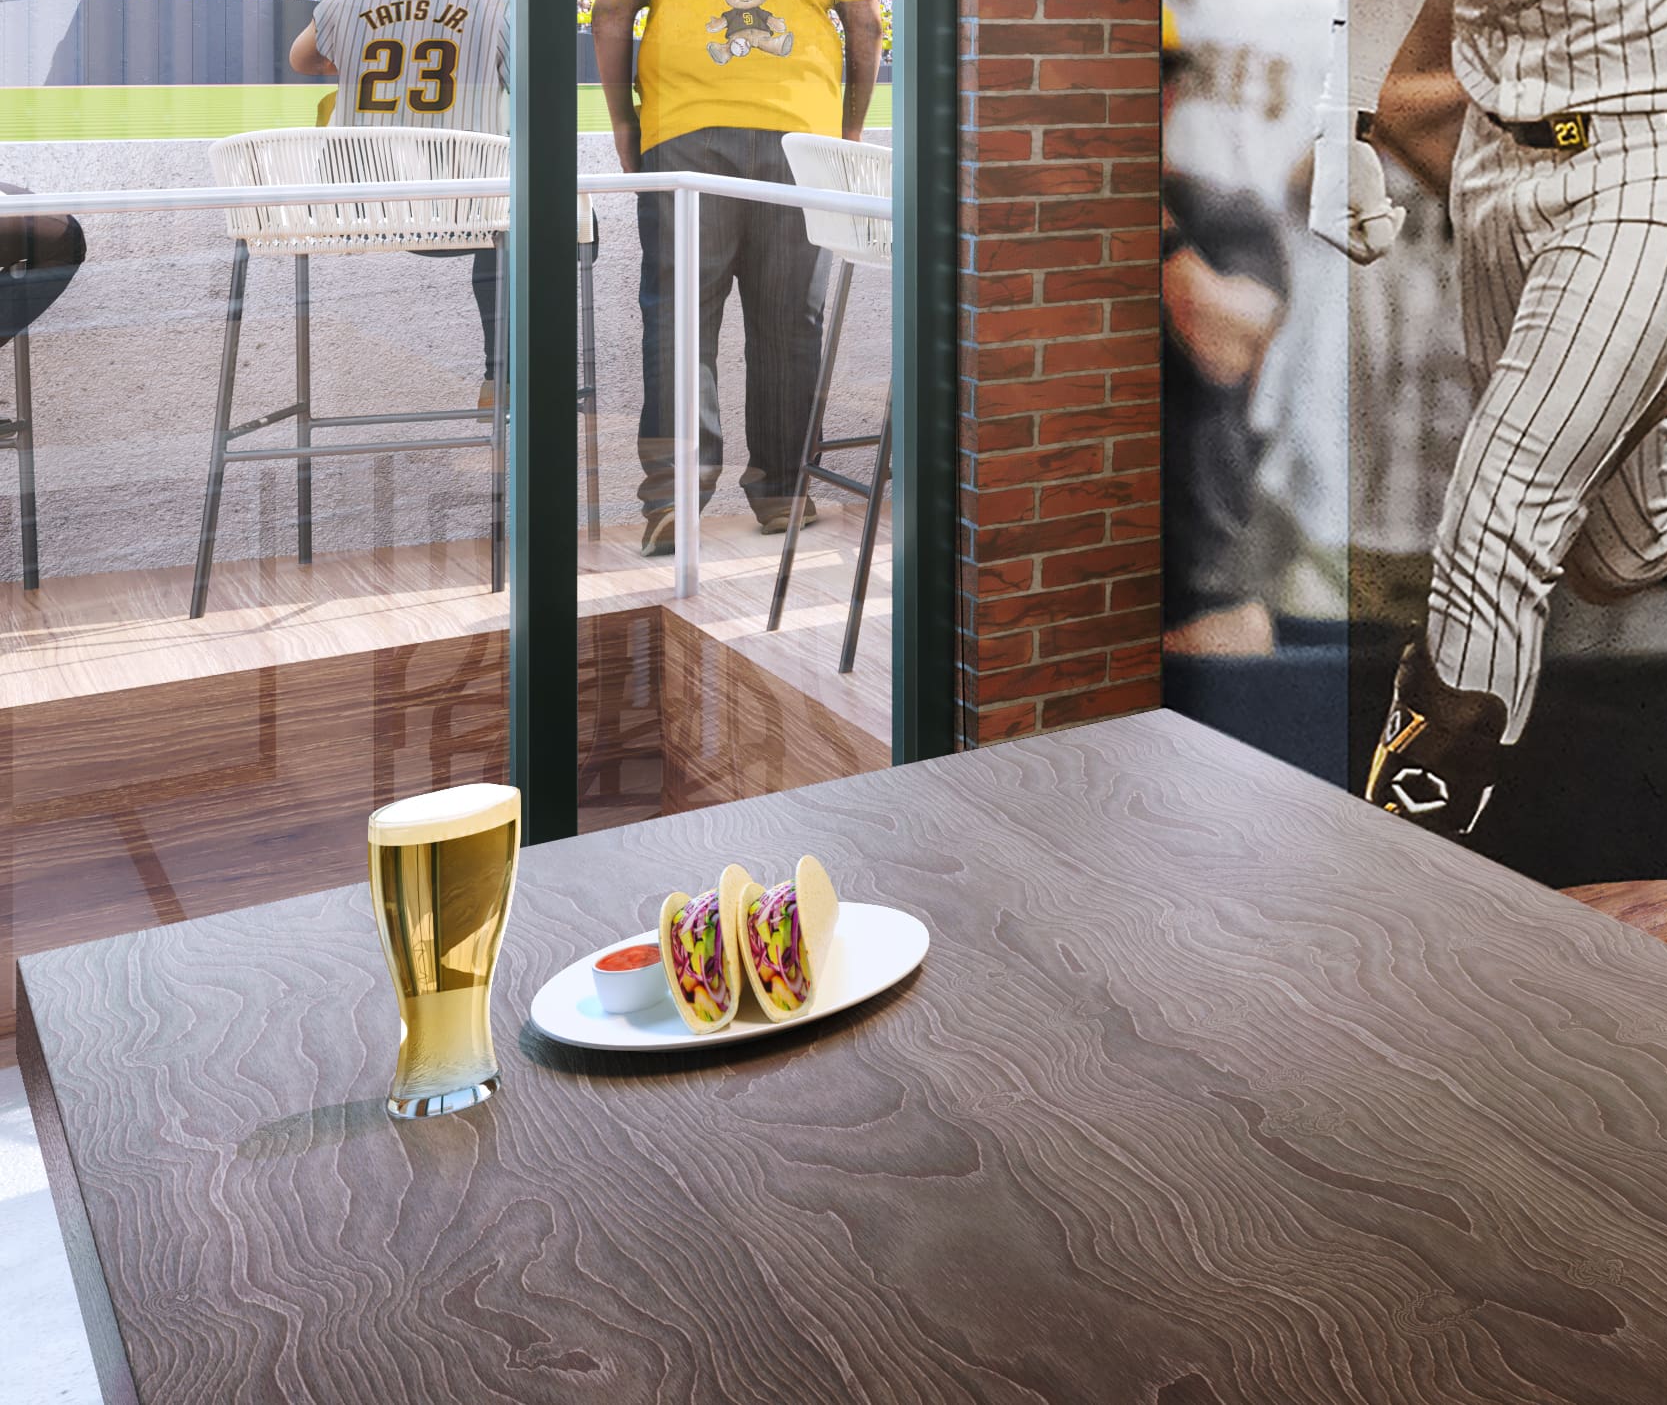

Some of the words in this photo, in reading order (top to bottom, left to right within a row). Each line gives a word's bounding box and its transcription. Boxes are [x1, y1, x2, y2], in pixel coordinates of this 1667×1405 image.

[359, 0, 430, 31] TATIS
[432, 3, 469, 34] JR.
[355, 38, 460, 114] 23
[1554, 121, 1580, 145] 23
